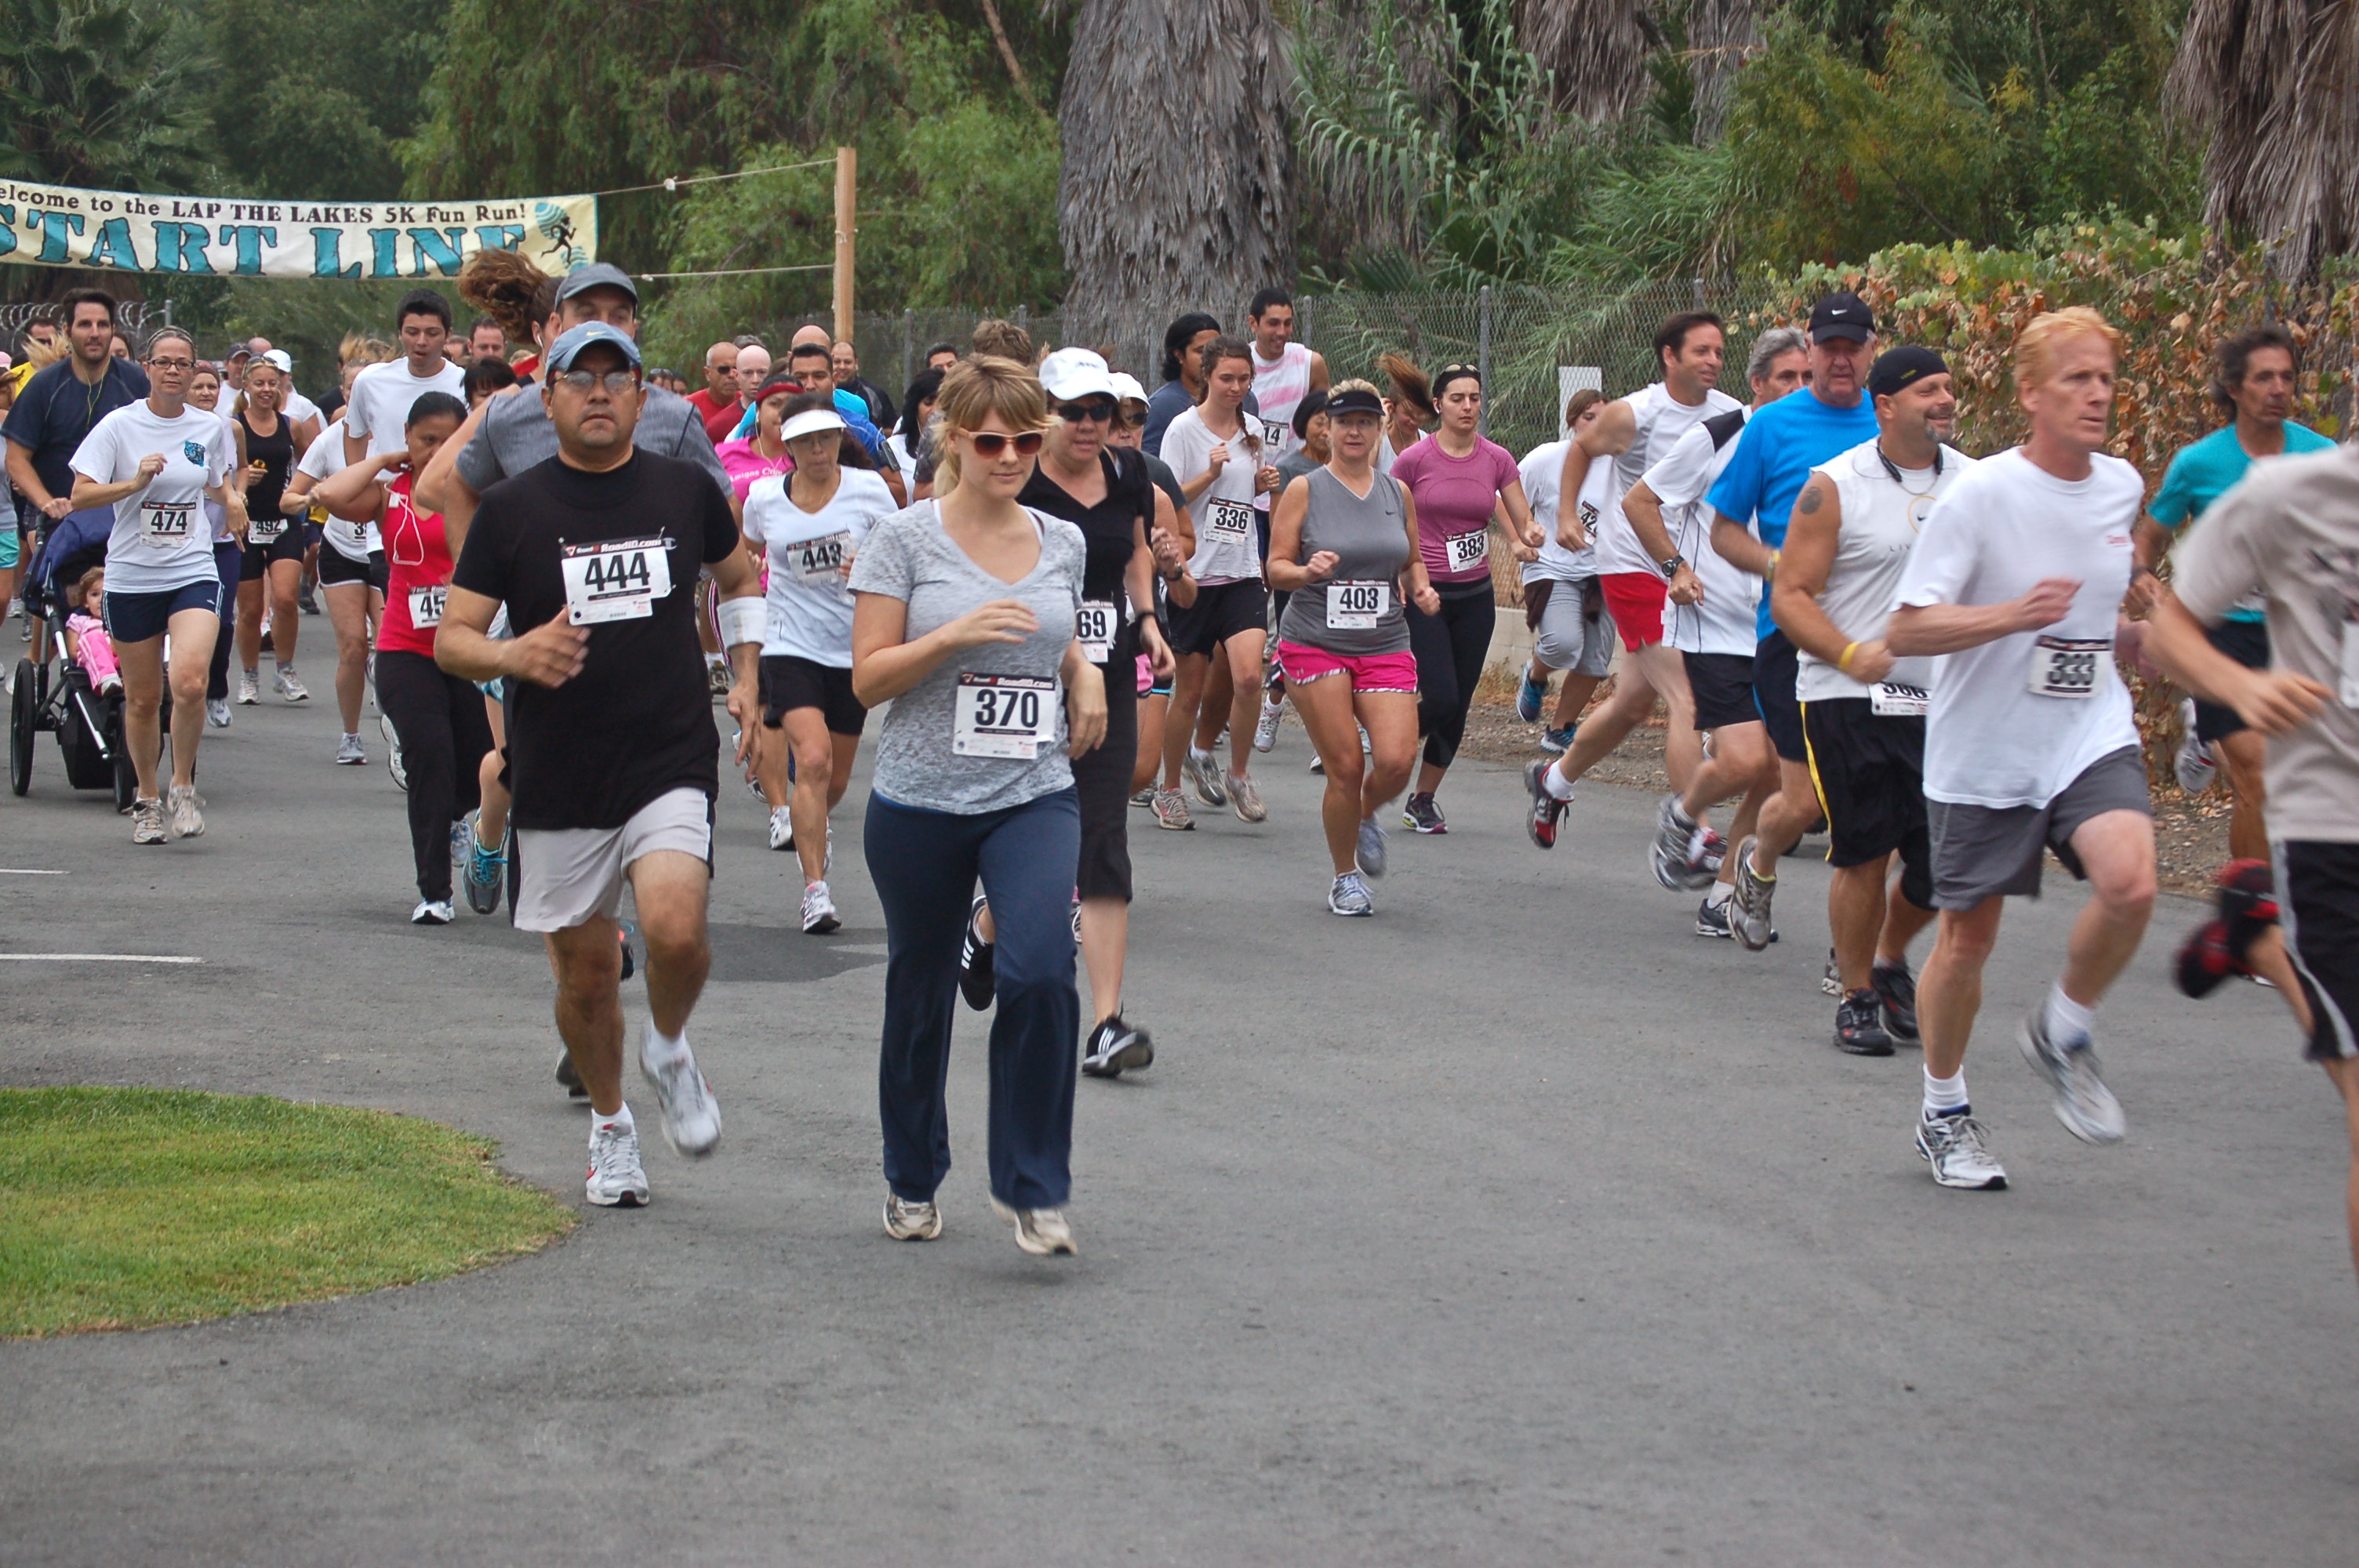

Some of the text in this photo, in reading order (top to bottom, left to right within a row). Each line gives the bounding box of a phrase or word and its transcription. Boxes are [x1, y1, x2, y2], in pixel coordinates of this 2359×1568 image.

[91, 197, 114, 212] to
[125, 198, 160, 216] the
[173, 201, 221, 219] LAP
[230, 204, 282, 222] THE
[291, 206, 373, 223] LAKES
[385, 206, 416, 223] 5K
[427, 206, 465, 223] Fun
[476, 203, 525, 221] Run!
[1263, 426, 1280, 443] 14
[151, 510, 187, 531] 474
[256, 520, 282, 533] 492
[1216, 506, 1248, 530] 336
[1456, 535, 1485, 559] 383
[584, 552, 650, 592] 444
[420, 595, 445, 616] 45
[1339, 587, 1379, 610] 403
[1077, 610, 1107, 638] 69
[2046, 652, 2095, 686] 333
[975, 688, 1039, 728] 370
